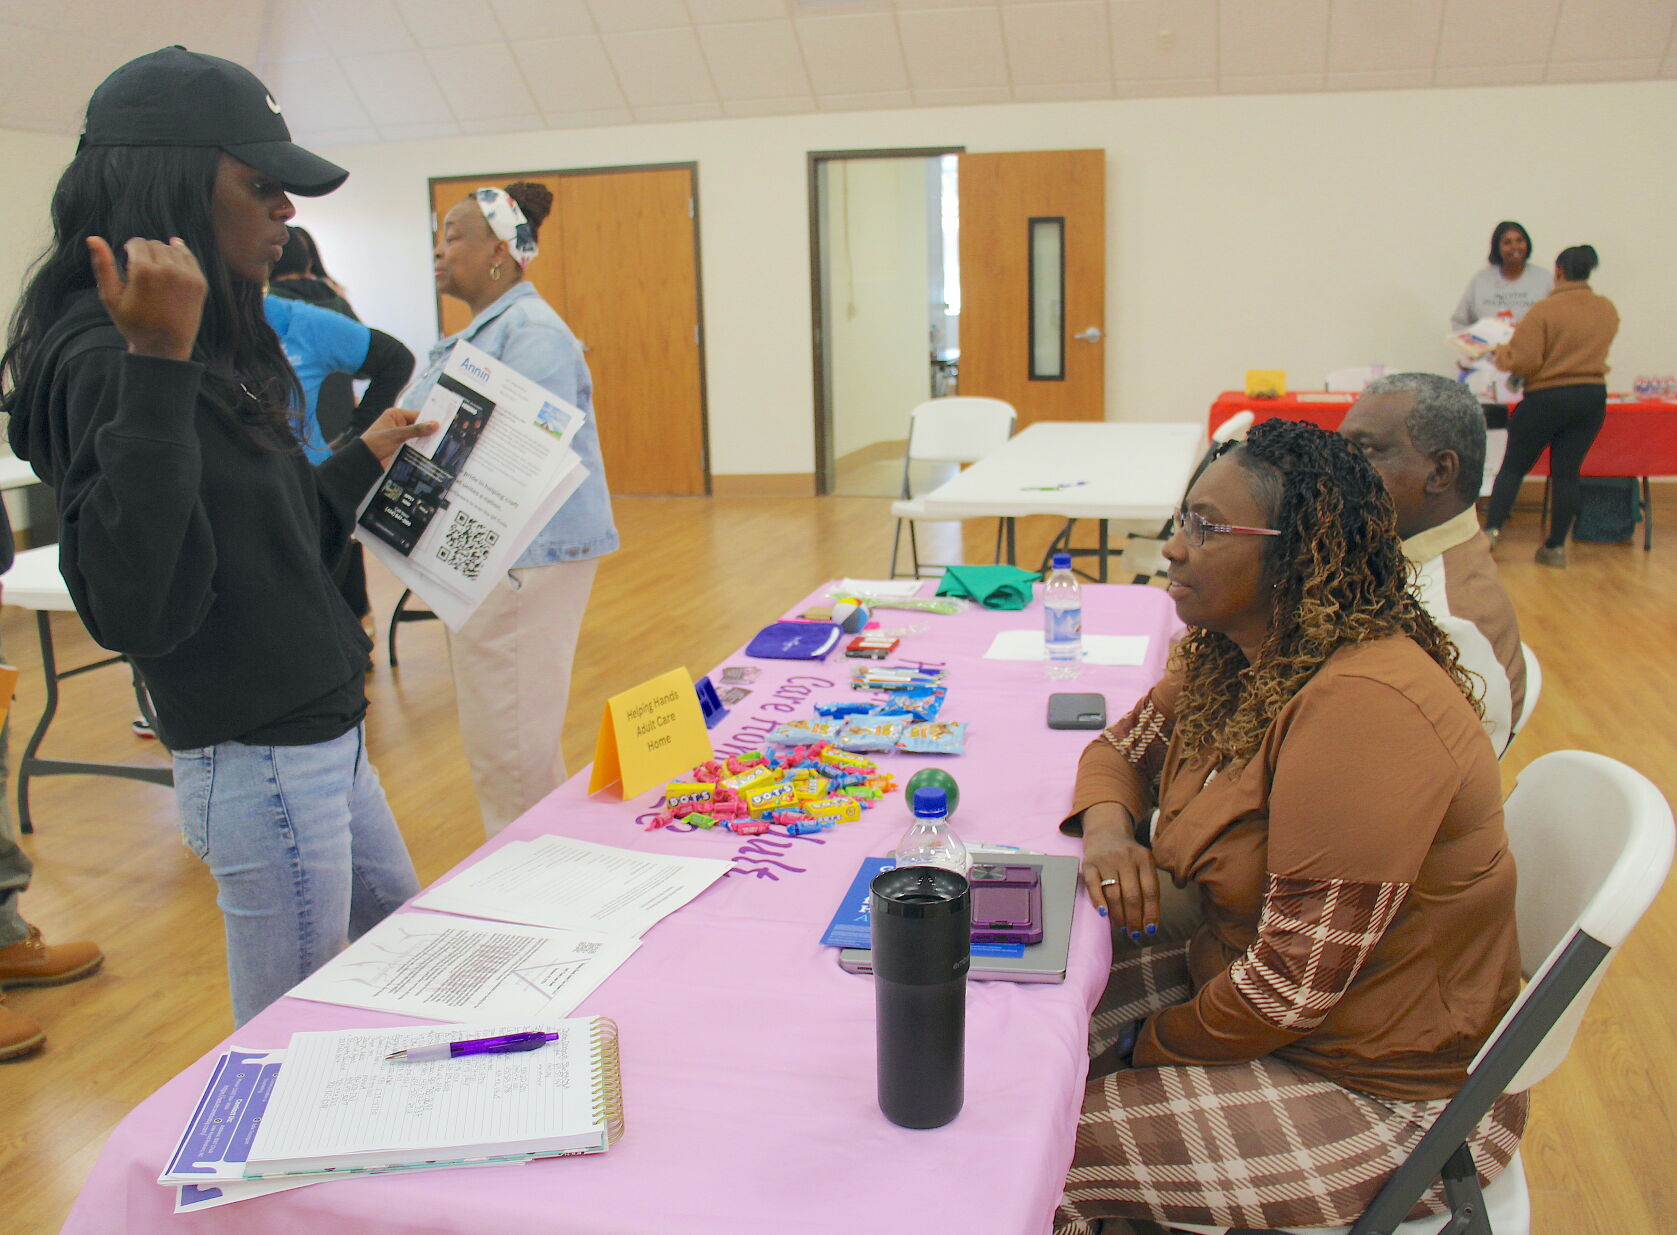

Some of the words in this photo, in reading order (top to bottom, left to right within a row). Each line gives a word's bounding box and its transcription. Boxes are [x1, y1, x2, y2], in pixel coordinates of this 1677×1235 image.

[461, 357, 491, 382] Annin
[627, 702, 654, 721] Helping
[653, 690, 680, 707] Hands
[760, 675, 835, 713] Care
[636, 720, 657, 737] Adult
[656, 711, 677, 728] Care
[647, 734, 672, 753] Home
[713, 716, 784, 761] Hom
[668, 790, 711, 807] DOTS
[751, 784, 793, 805] DOTS
